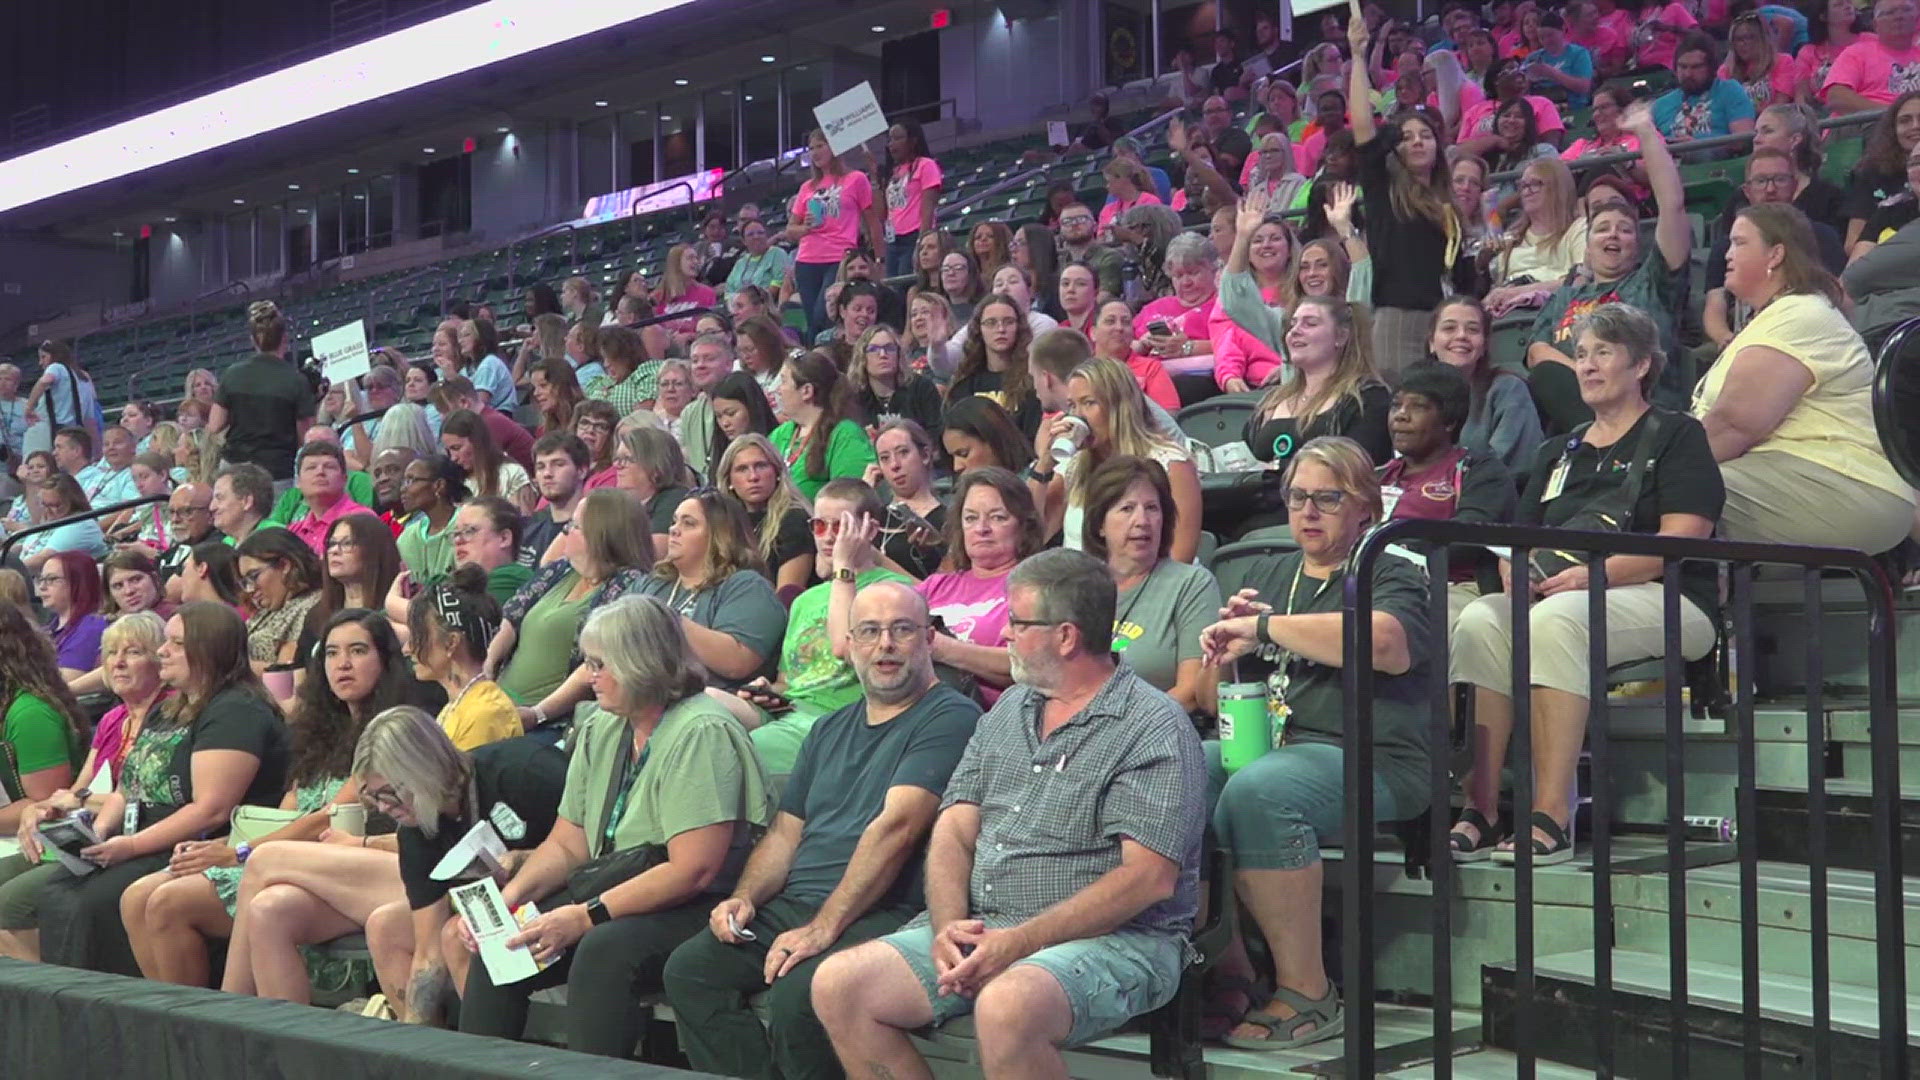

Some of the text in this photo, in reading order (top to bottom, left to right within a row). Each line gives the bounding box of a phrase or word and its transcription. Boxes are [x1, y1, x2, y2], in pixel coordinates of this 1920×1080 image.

[843, 102, 876, 120] WILLIAMS
[329, 341, 364, 359] BLUE GRASS
